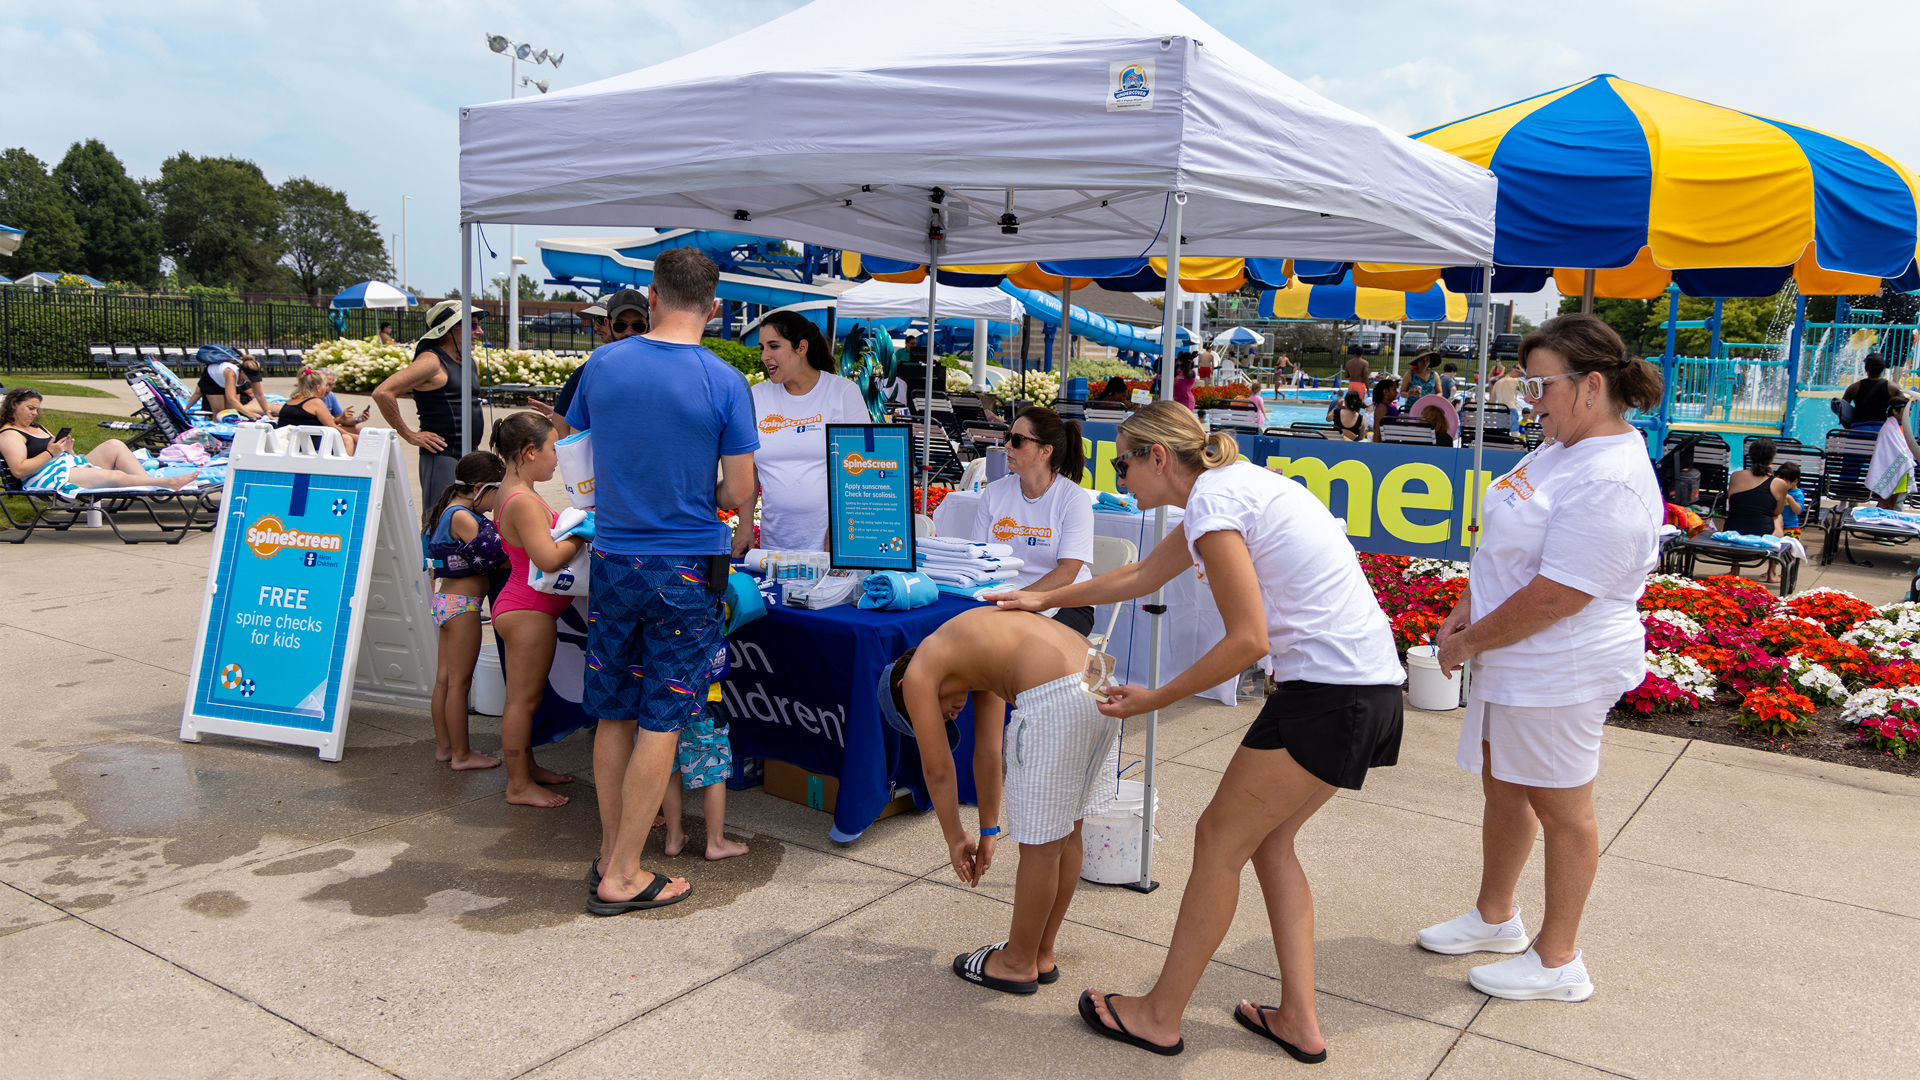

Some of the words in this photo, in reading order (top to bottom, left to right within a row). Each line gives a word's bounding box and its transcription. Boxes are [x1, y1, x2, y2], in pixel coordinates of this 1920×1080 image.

[759, 414, 821, 429] SpineScreen
[843, 459, 898, 469] SpineScreen
[246, 527, 341, 550] SpineScreen
[993, 524, 1051, 537] SpineScreen
[258, 586, 309, 609] FREE
[236, 610, 272, 628] spine
[275, 613, 323, 633] checks
[251, 629, 270, 645] for
[273, 631, 300, 648] kids
